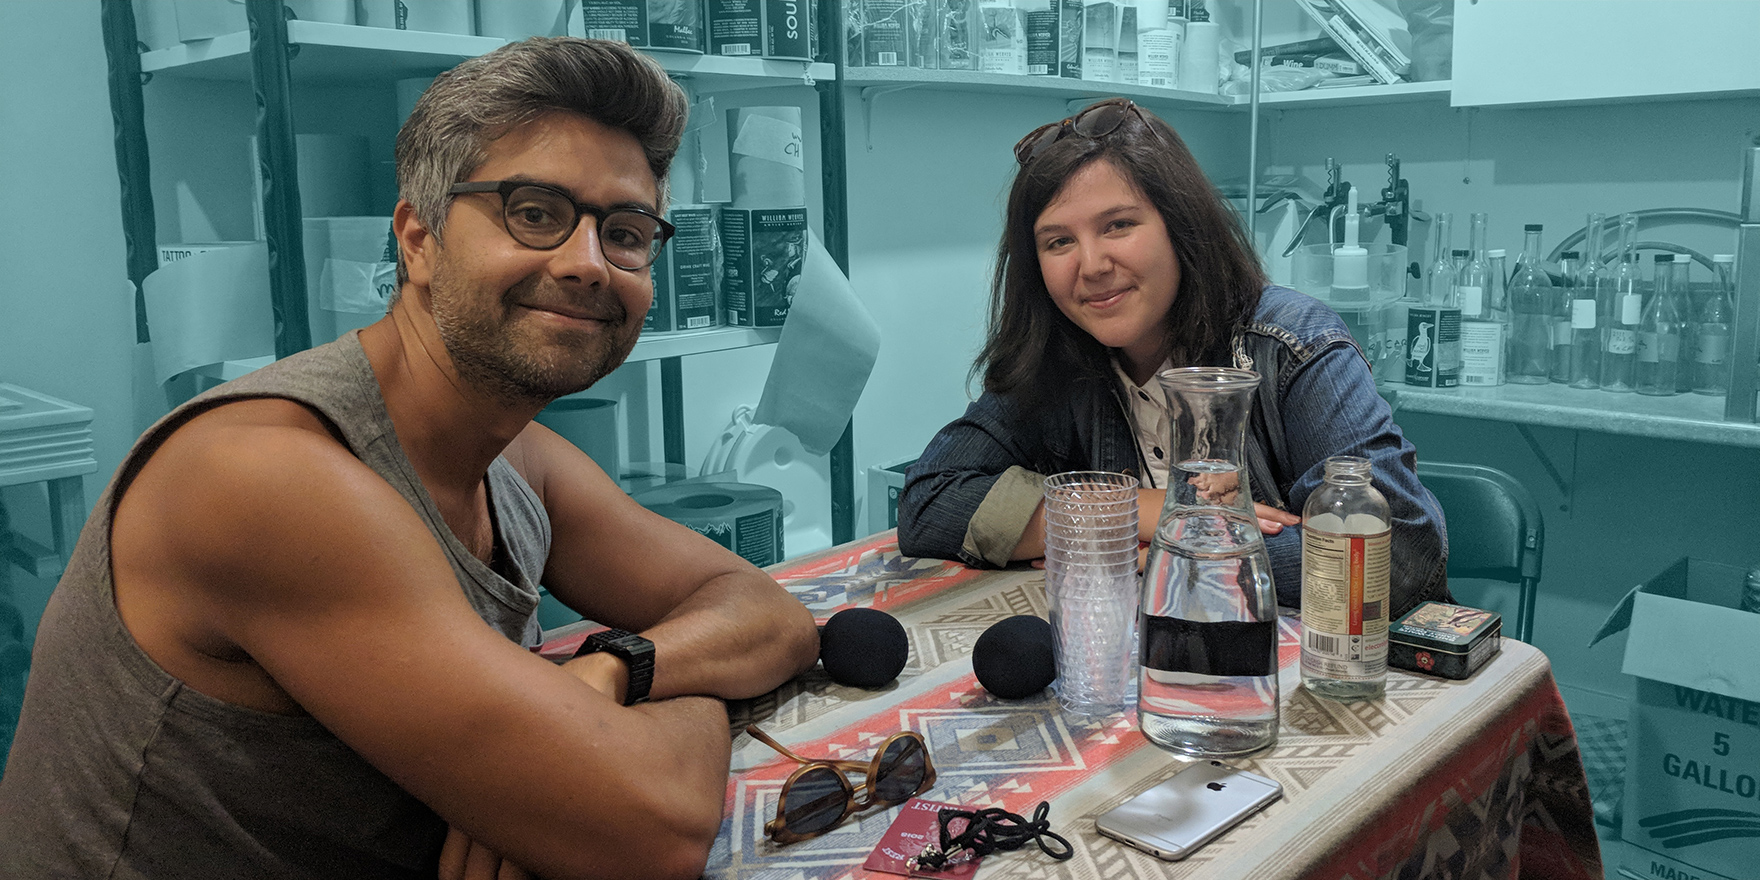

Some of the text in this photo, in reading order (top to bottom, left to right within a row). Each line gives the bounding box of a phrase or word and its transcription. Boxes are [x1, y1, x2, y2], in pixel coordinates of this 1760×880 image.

[785, 0, 798, 39] SOU
[1713, 731, 1730, 756] 5
[1663, 753, 1760, 801] GALLO
